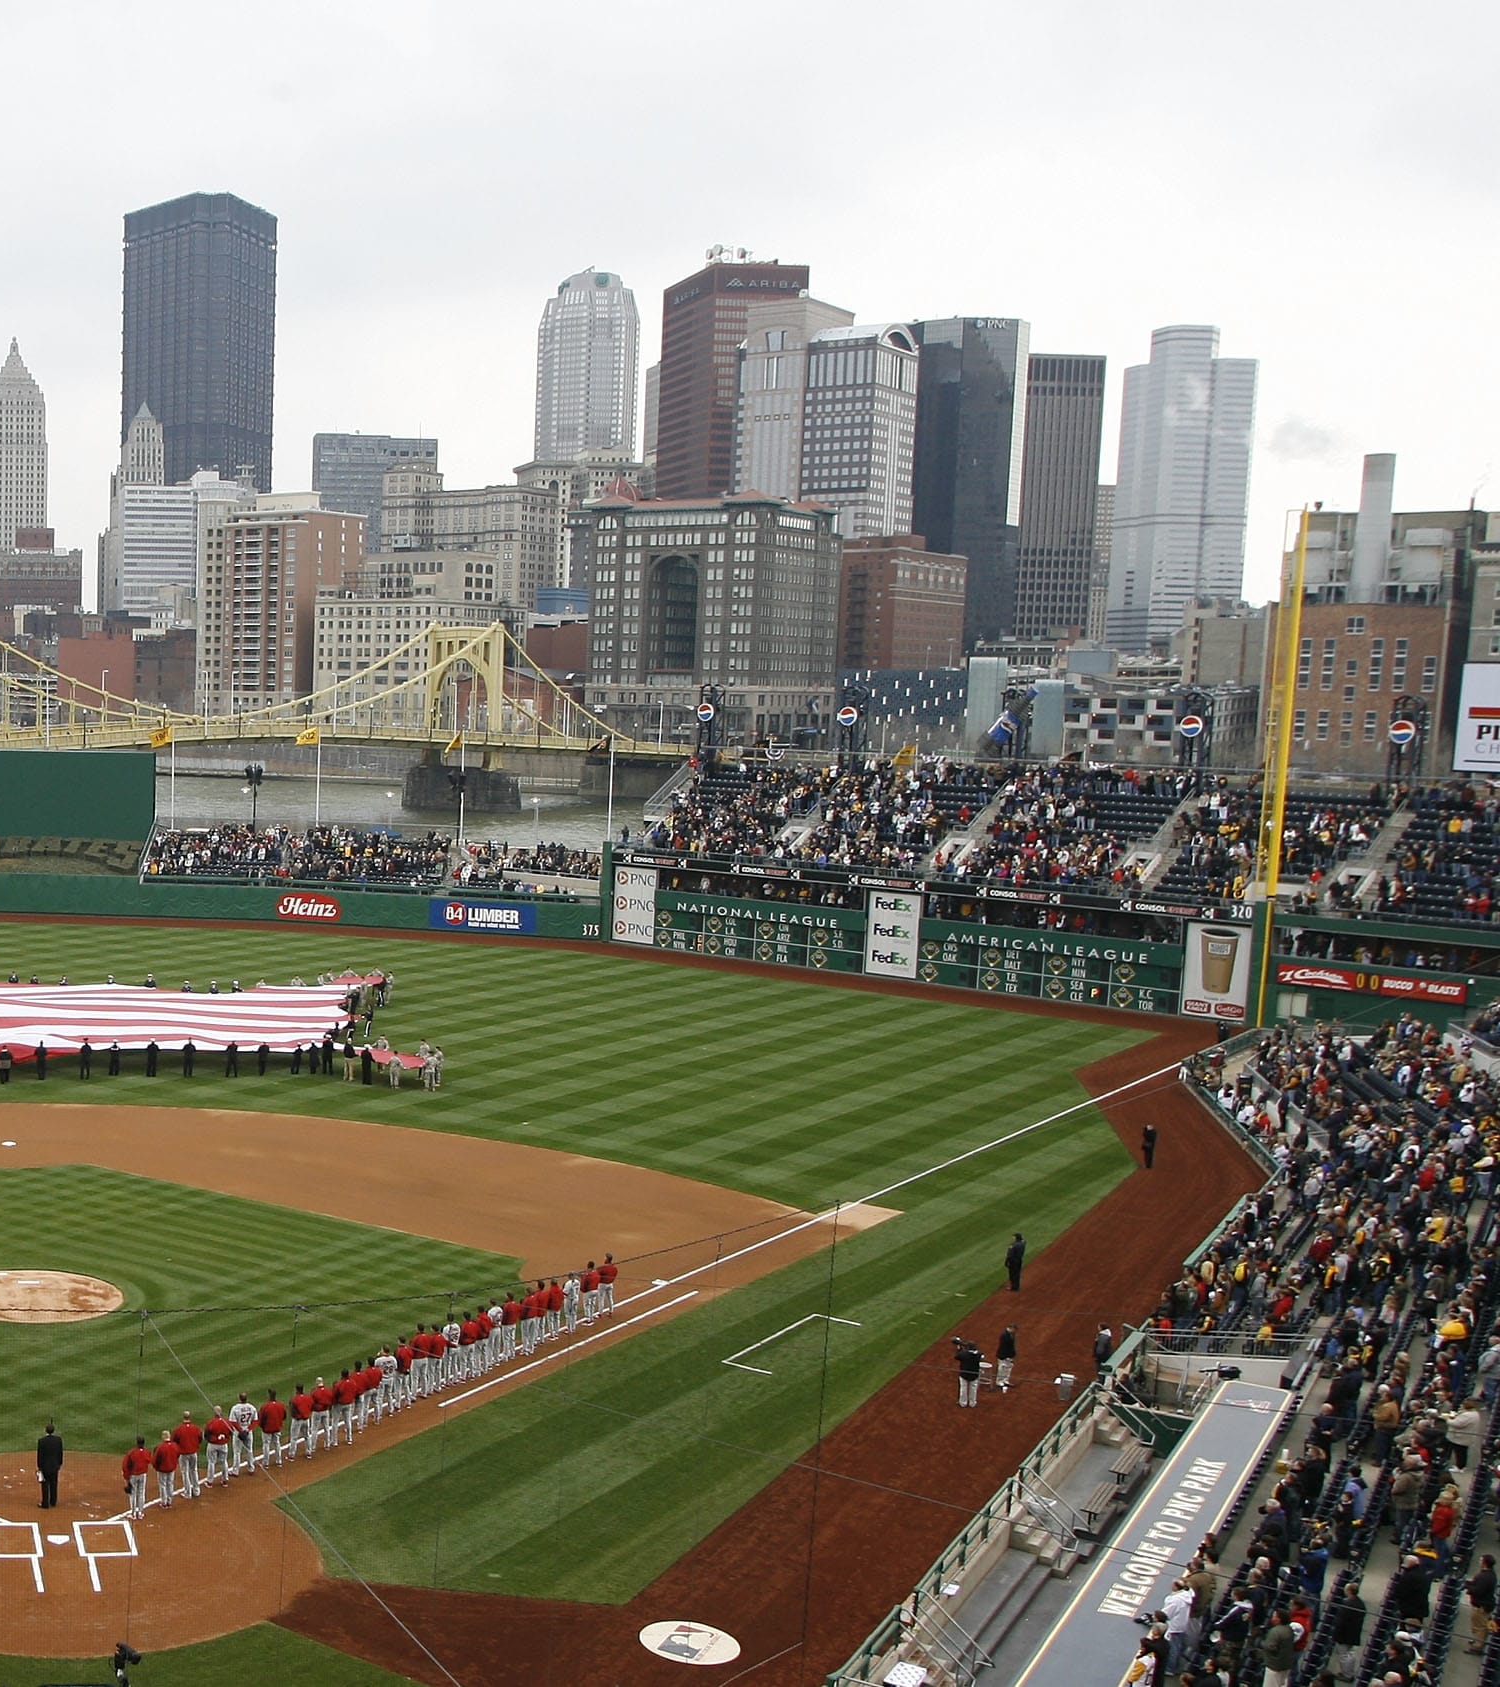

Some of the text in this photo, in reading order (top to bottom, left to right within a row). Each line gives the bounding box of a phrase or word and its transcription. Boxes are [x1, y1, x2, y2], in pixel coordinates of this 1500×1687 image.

[987, 320, 1011, 329] PNC
[741, 866, 765, 875] CONSOL
[630, 873, 655, 887] PNC
[861, 878, 887, 886] CONSOL
[990, 890, 1018, 898] CONSOL
[278, 897, 337, 917] Heinz
[628, 898, 654, 912] PNC
[875, 896, 911, 912] FedEx
[1135, 903, 1167, 912] CONSOL
[445, 906, 519, 924] 84 LUMBER
[677, 902, 837, 928] NATIONAL LEAGUE
[1231, 905, 1252, 919] 320
[582, 924, 599, 936] 375
[627, 923, 653, 937] PNC
[874, 923, 910, 938] FedEx
[947, 933, 1148, 964] AMERICAN LEAGUE
[776, 954, 788, 963] FLA
[871, 950, 908, 965] FedEx
[943, 953, 957, 962] OAK
[1005, 983, 1017, 993] TEX
[1070, 980, 1084, 990] SEA
[1382, 979, 1461, 995] BUCCO BLASTS
[1070, 992, 1083, 1002] CLE
[1138, 1001, 1154, 1011] TOR
[241, 1412, 252, 1423] 27
[1097, 1457, 1228, 1617] WELCOME TO PNC PARK
